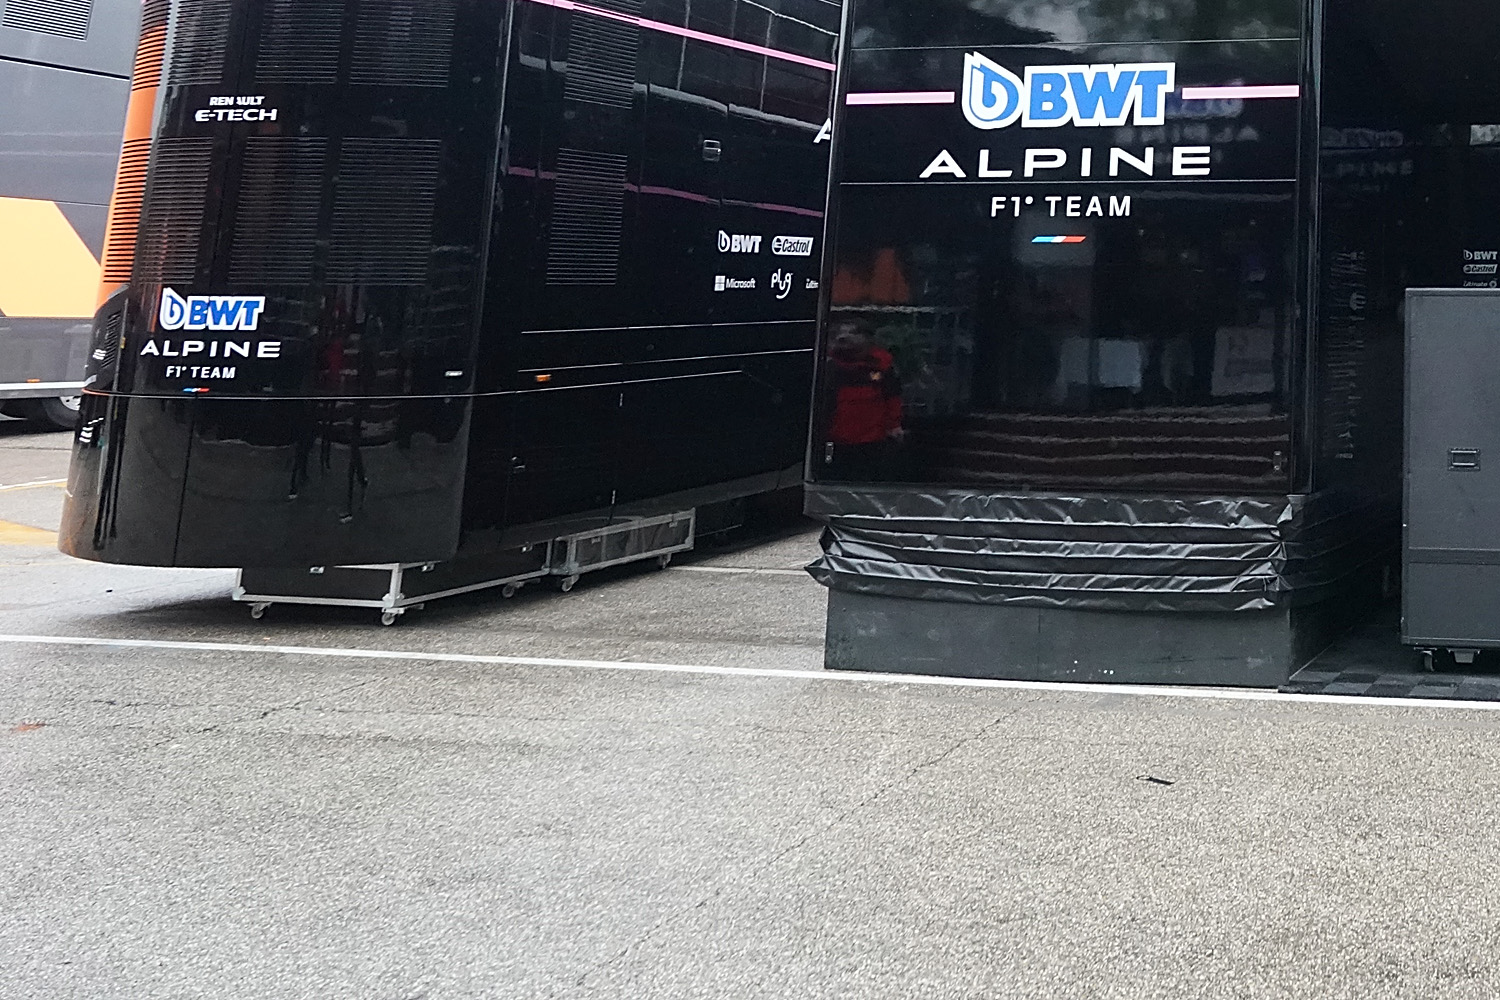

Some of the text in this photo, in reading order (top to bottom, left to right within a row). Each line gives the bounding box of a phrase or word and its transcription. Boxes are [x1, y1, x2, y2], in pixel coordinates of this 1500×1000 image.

[1022, 62, 1175, 128] BWT
[195, 109, 277, 122] E-TECH
[920, 146, 1210, 178] ALPINE
[1045, 195, 1131, 217] TEAM
[730, 235, 762, 253] BWT
[782, 238, 811, 254] Castrol
[1474, 251, 1498, 260] BWT
[726, 278, 756, 289] Microsoft
[770, 268, 792, 300] plug
[184, 295, 265, 331] BWT
[140, 339, 281, 358] ALPINE
[190, 366, 236, 379] TEAM
